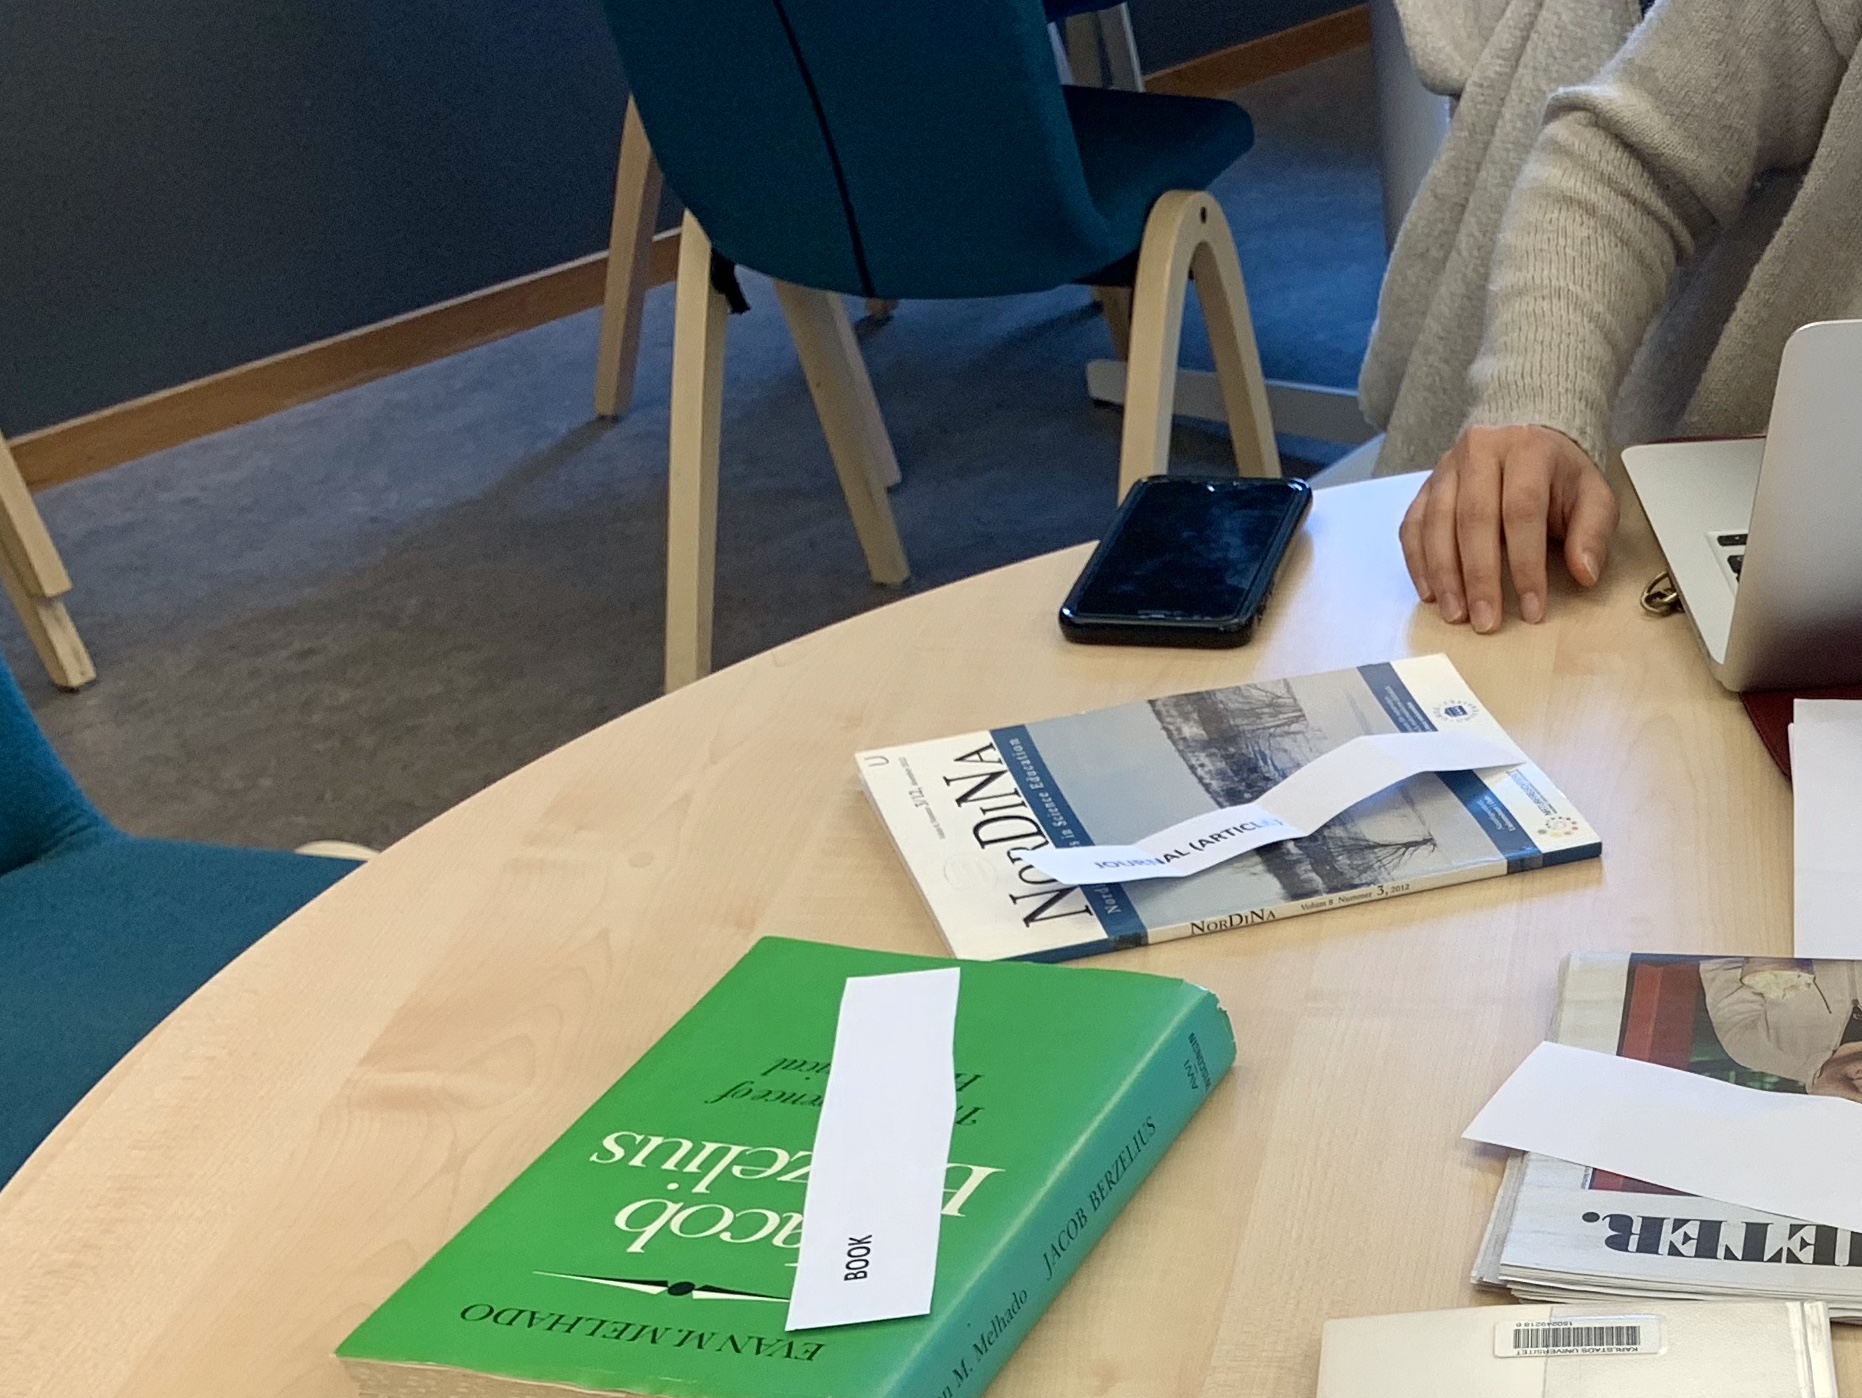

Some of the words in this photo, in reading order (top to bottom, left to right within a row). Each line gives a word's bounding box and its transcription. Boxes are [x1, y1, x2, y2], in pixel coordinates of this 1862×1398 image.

[1009, 738, 1046, 790] Education
[1038, 790, 1068, 829] Science
[1061, 827, 1075, 841] in
[1094, 846, 1191, 870] JOURNAL
[1390, 882, 1411, 893] 2012
[705, 1079, 746, 1105] of
[590, 1131, 1005, 1217] Bzelius
[613, 1198, 803, 1267] acob
[844, 1234, 872, 1282] BOOK
[952, 1361, 973, 1388] M.
[971, 1288, 1029, 1361] Melhado
[1041, 1207, 1088, 1280] JACOB
[1090, 1116, 1157, 1211] BERZELIUS
[460, 1302, 671, 1345] MELHADO
[674, 1327, 719, 1351] M.
[719, 1335, 826, 1363] EVAN
[1516, 1348, 1578, 1356] UNIVERSITET
